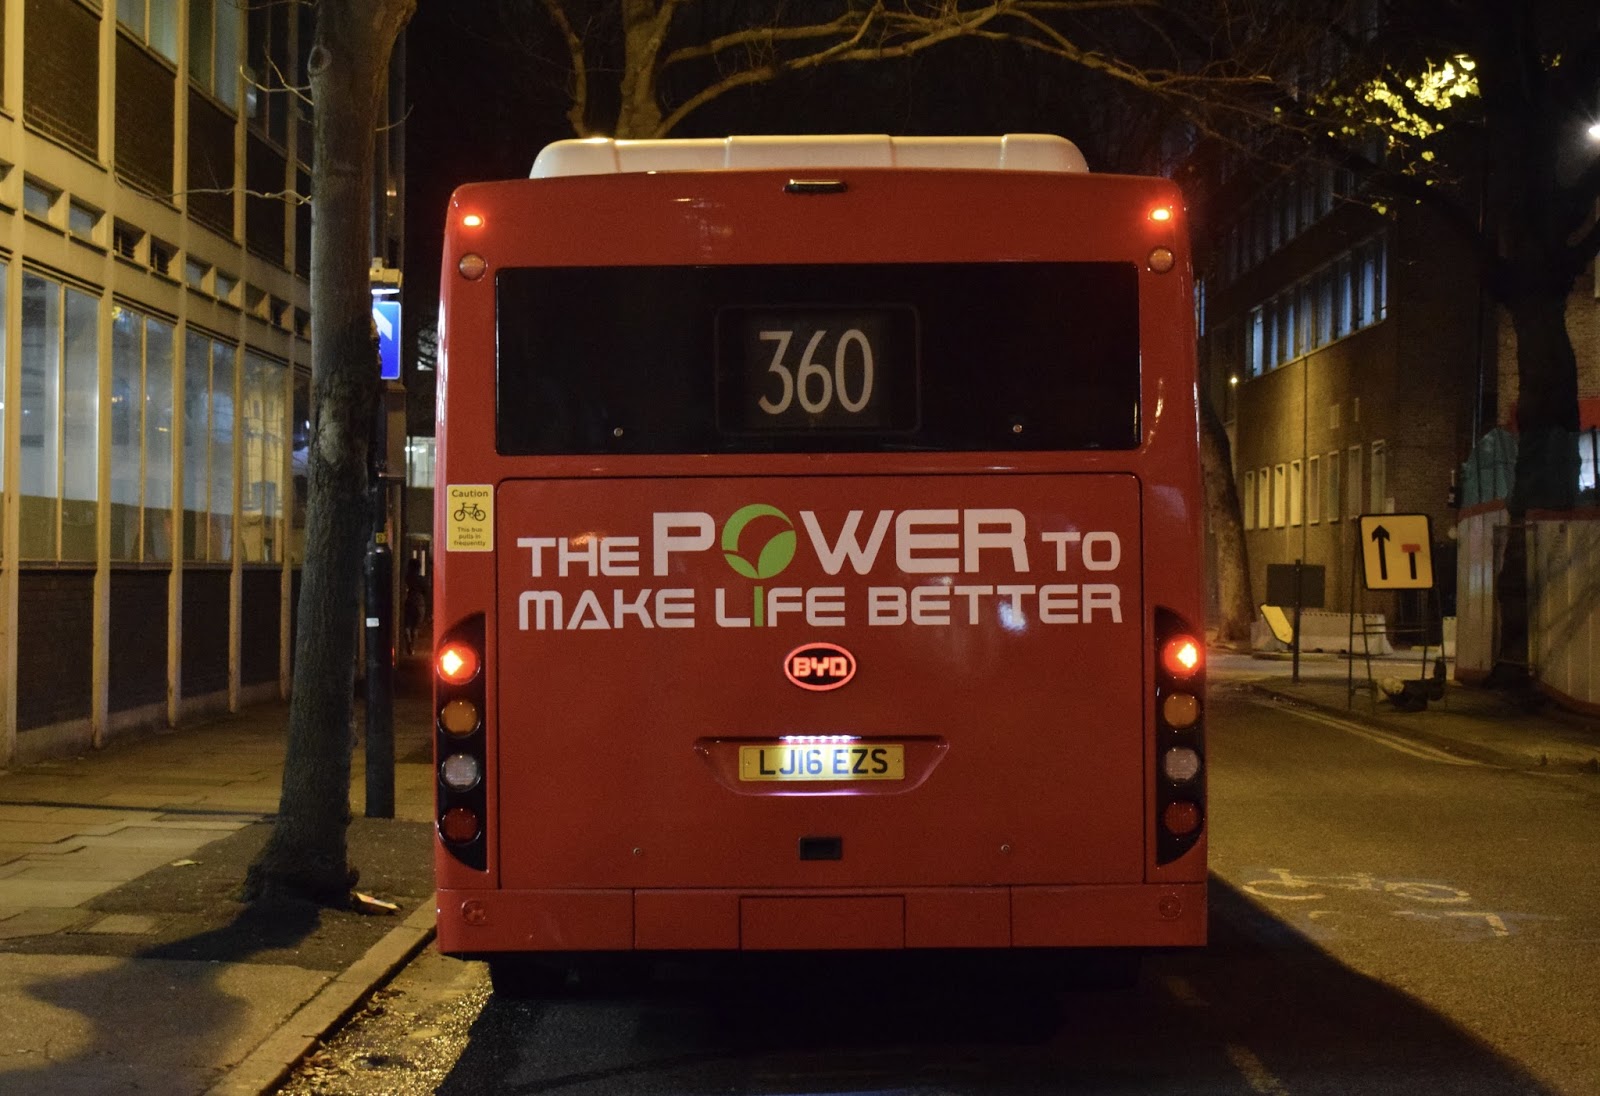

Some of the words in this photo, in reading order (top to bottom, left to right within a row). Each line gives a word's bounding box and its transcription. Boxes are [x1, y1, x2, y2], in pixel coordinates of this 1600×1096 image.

[758, 329, 873, 414] 360
[452, 489, 488, 497] Caution
[517, 536, 640, 577] THE
[653, 503, 1030, 579] POWER
[1041, 531, 1121, 572] TO
[518, 588, 696, 631] MAKE
[715, 586, 845, 628] LIFE
[868, 583, 1123, 626] BETTER
[792, 656, 848, 678] BYD
[759, 749, 823, 775] LJ16
[832, 748, 888, 775] EZS
